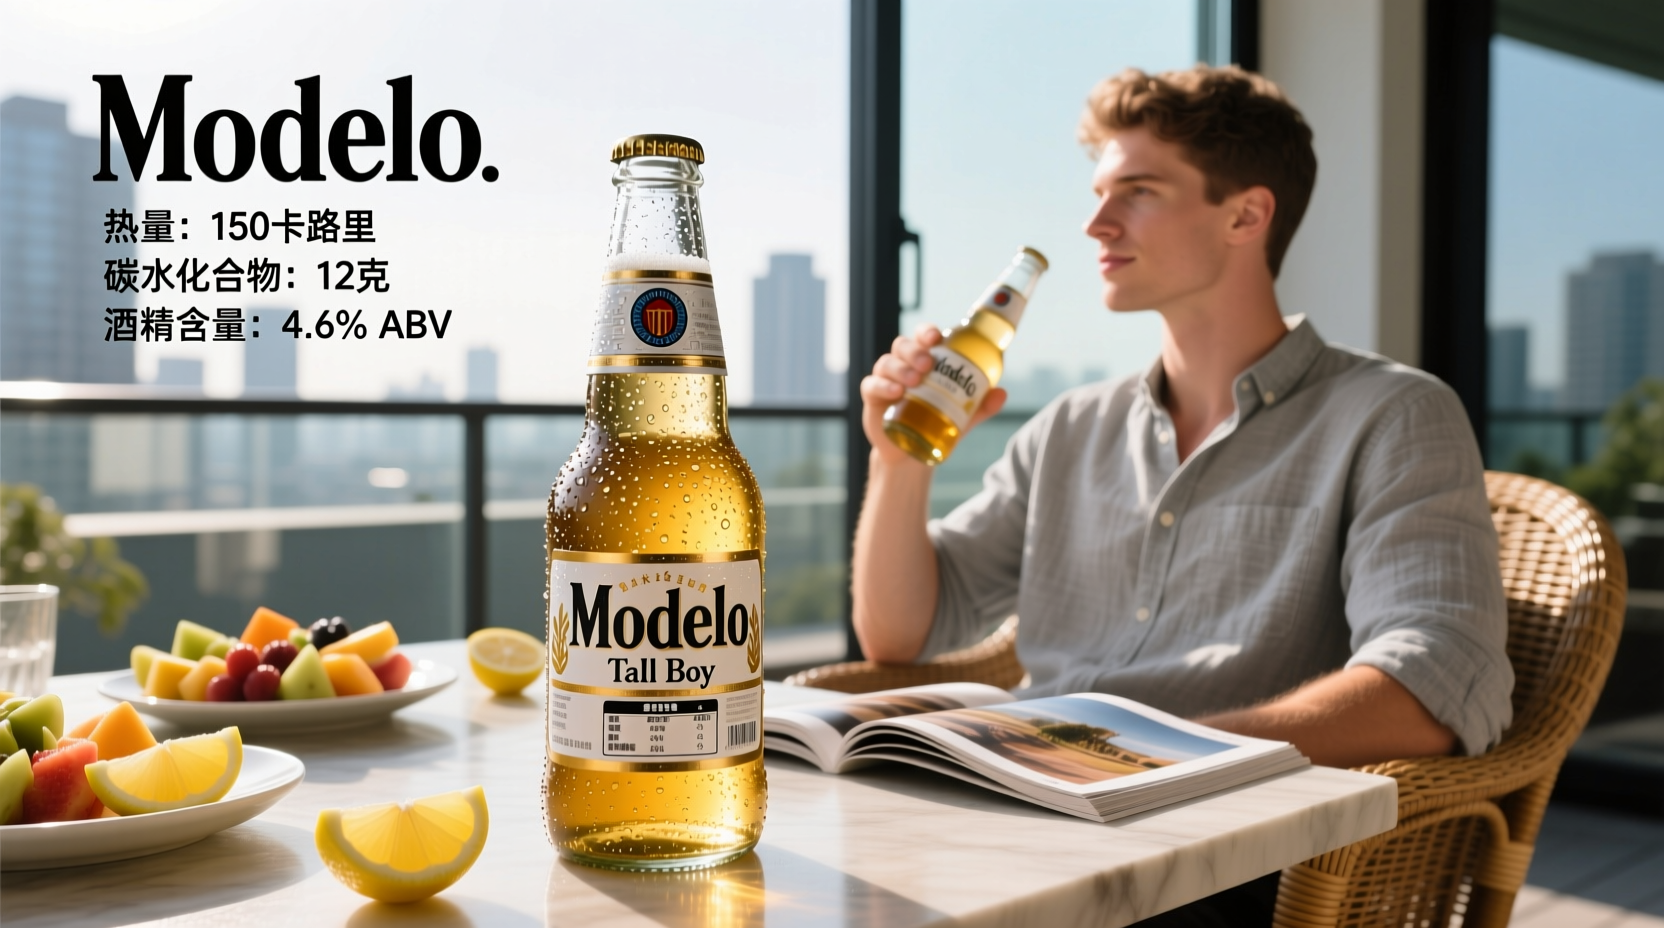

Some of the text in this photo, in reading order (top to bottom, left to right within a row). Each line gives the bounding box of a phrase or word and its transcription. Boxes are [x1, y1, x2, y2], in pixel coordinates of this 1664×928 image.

[569, 582, 749, 650] Modelo
[607, 658, 716, 690] Tall Boy
